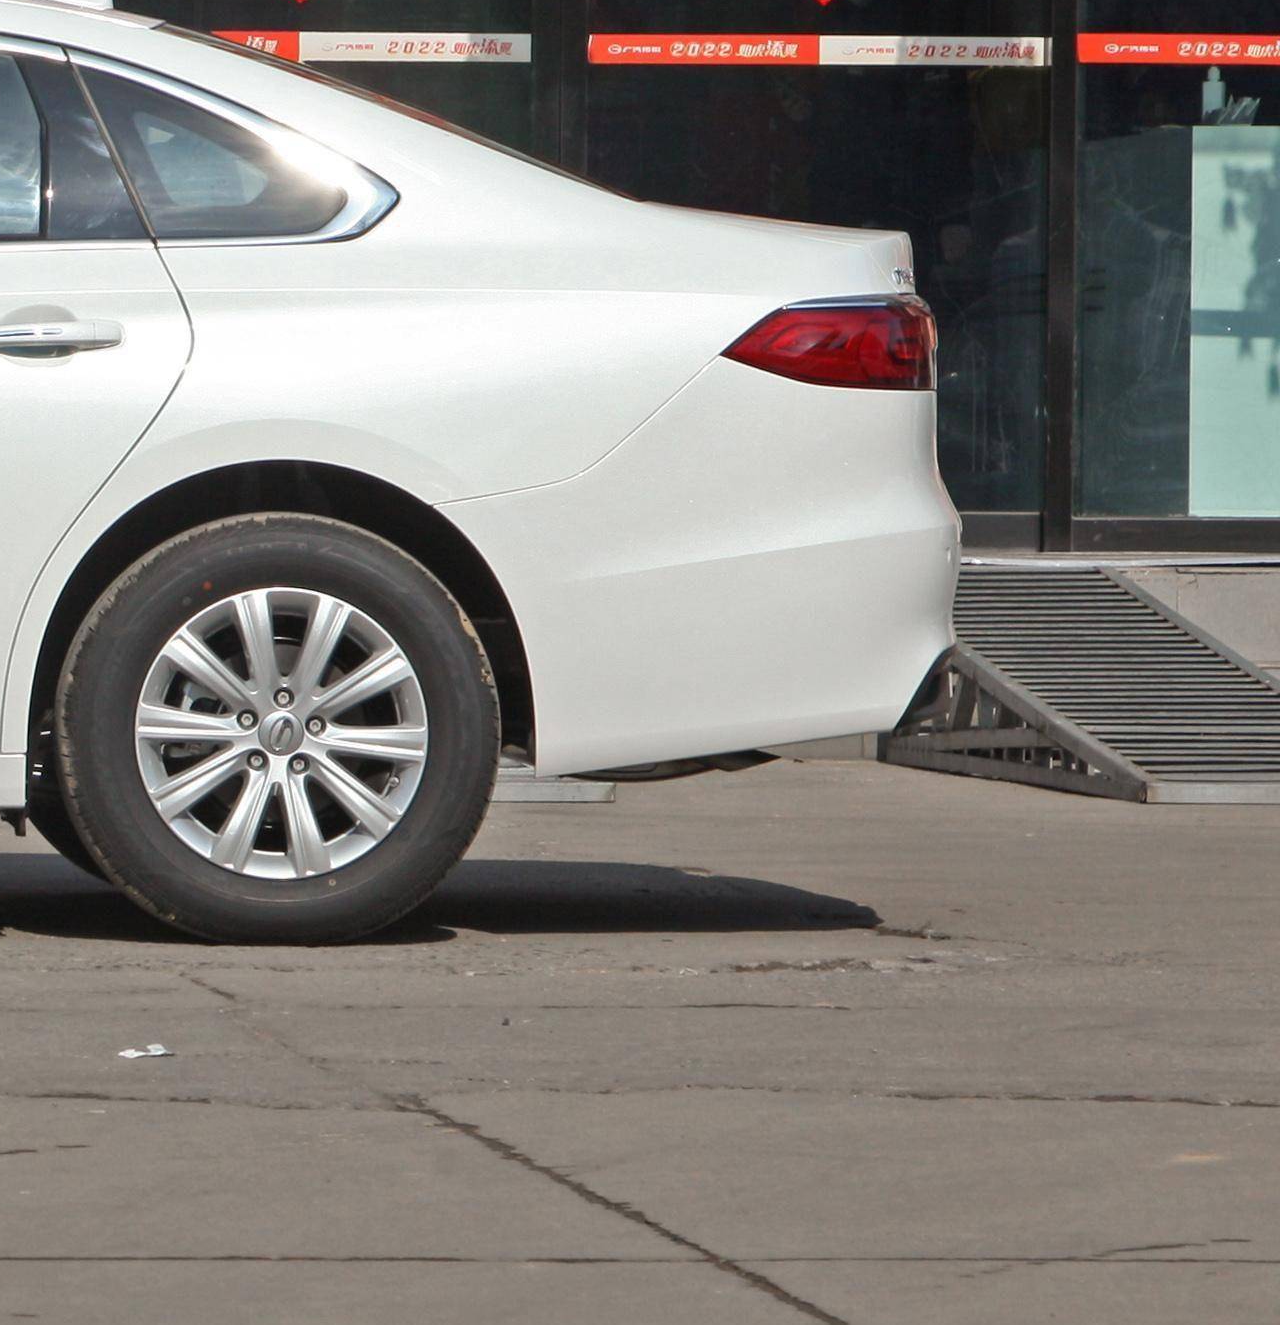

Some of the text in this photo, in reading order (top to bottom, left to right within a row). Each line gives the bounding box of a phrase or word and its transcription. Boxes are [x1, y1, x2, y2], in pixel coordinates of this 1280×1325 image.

[387, 40, 446, 55] 2022
[670, 41, 732, 58] 2022
[907, 44, 968, 59] 2022
[1177, 41, 1241, 58] 2022
[1243, 39, 1280, 58] 如虎
